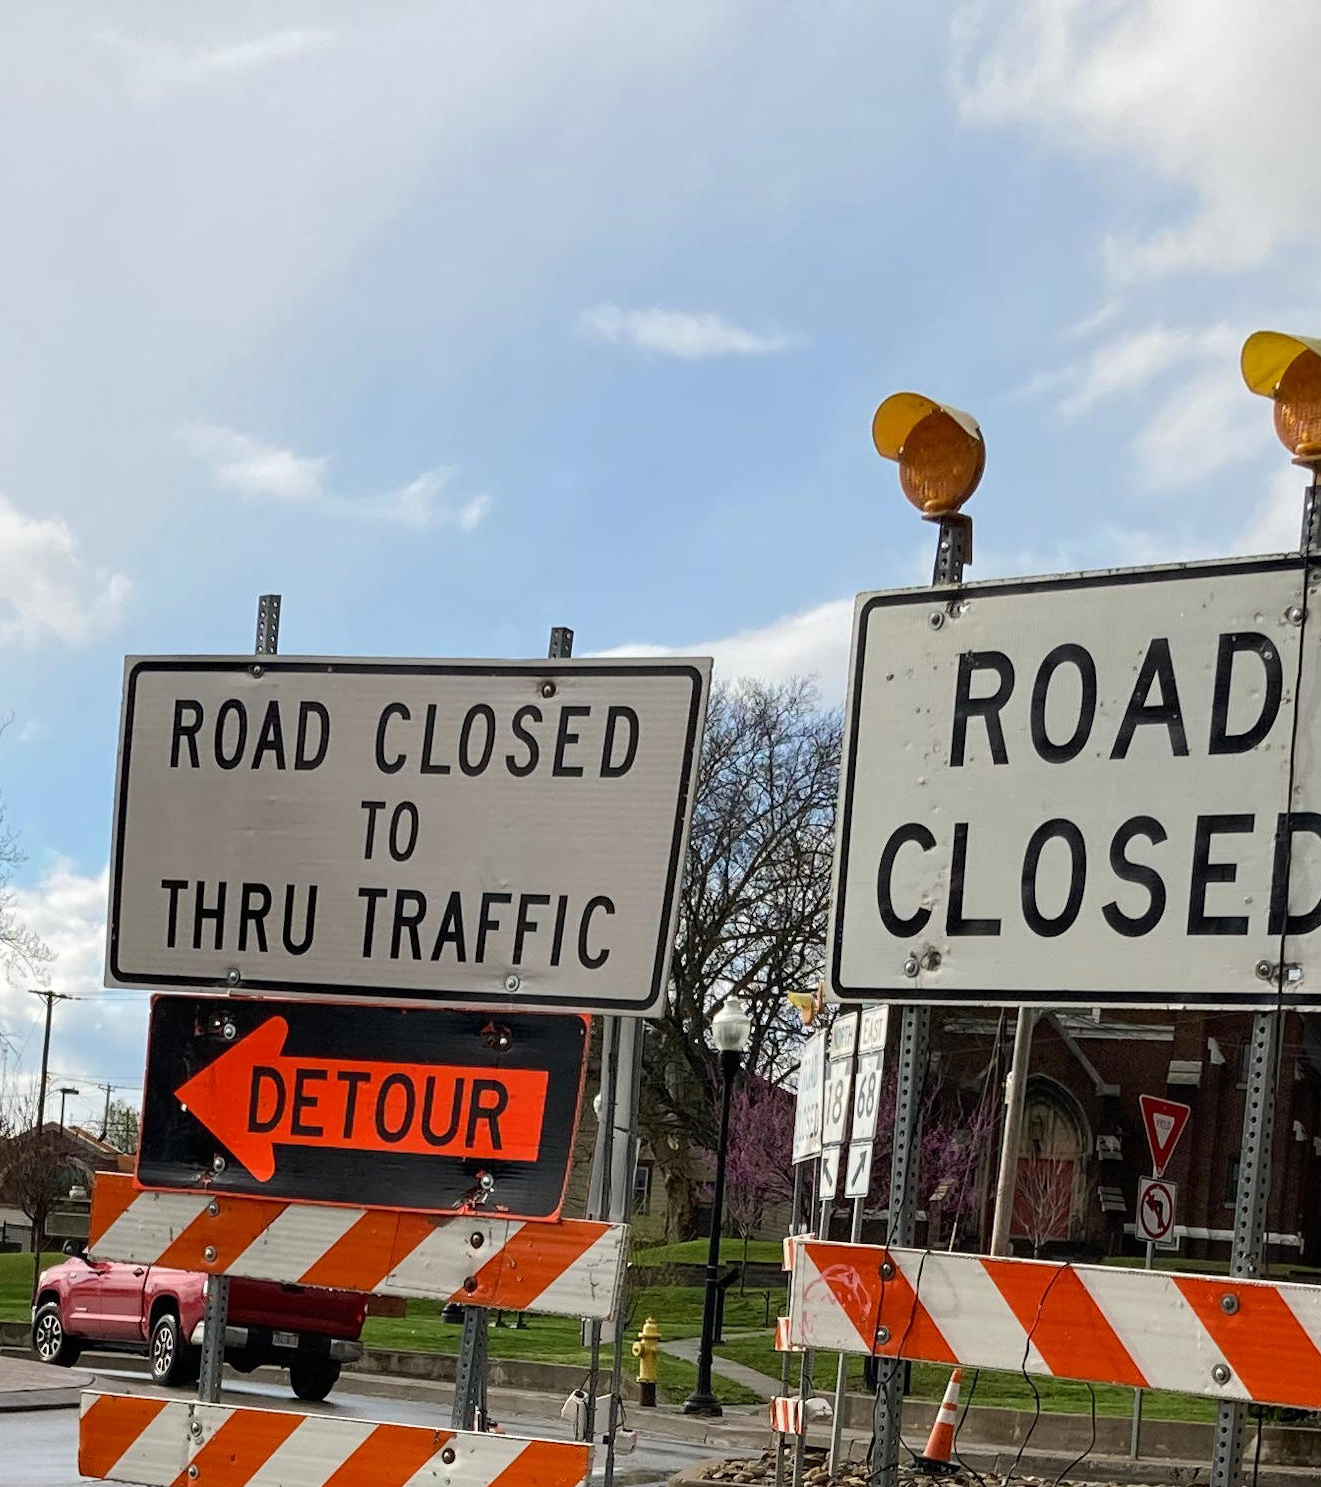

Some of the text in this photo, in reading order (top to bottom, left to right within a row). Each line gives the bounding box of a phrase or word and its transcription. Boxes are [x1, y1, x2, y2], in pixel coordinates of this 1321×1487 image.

[949, 631, 1284, 768] ROAD
[169, 698, 640, 778] ROAD CLOSED
[360, 799, 419, 862] TO
[161, 878, 616, 970] THRU TRAFFIC
[862, 1017, 883, 1045] EAST
[247, 1066, 509, 1150] DETOUR
[827, 1079, 843, 1125] 18
[857, 1072, 876, 1119] 68
